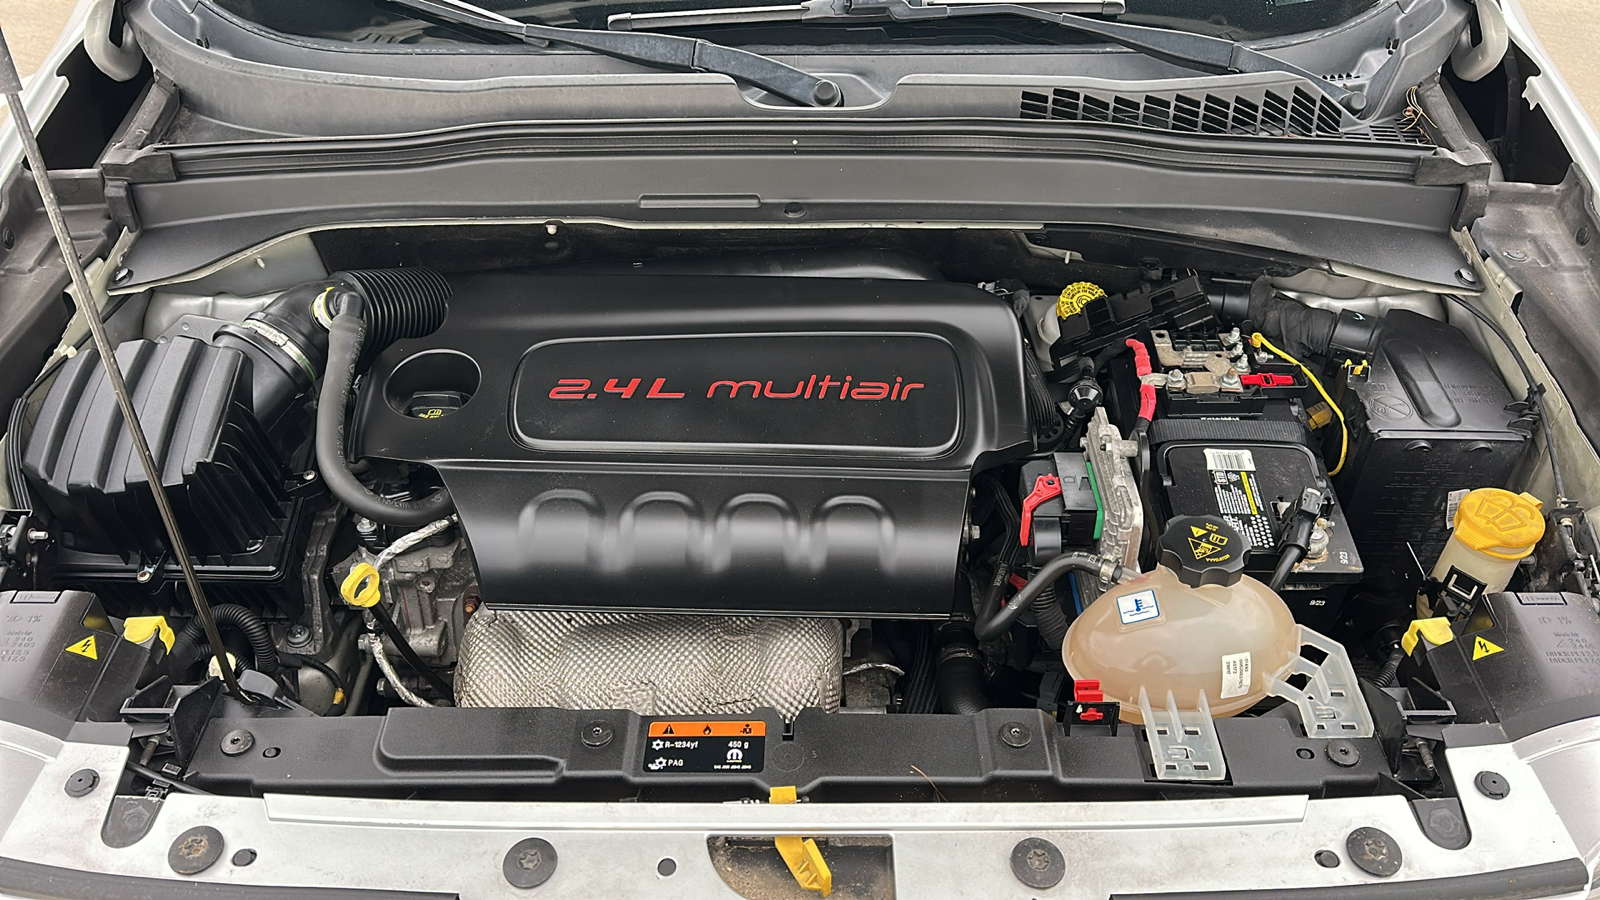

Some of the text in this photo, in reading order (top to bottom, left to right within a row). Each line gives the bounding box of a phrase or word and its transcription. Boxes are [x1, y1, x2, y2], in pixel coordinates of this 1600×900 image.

[707, 374, 924, 401] multiair
[1339, 551, 1349, 565] 9/23
[1309, 599, 1326, 607] 9/23
[664, 740, 749, 749] R-1234yf 450 g
[667, 759, 684, 767] PAG
